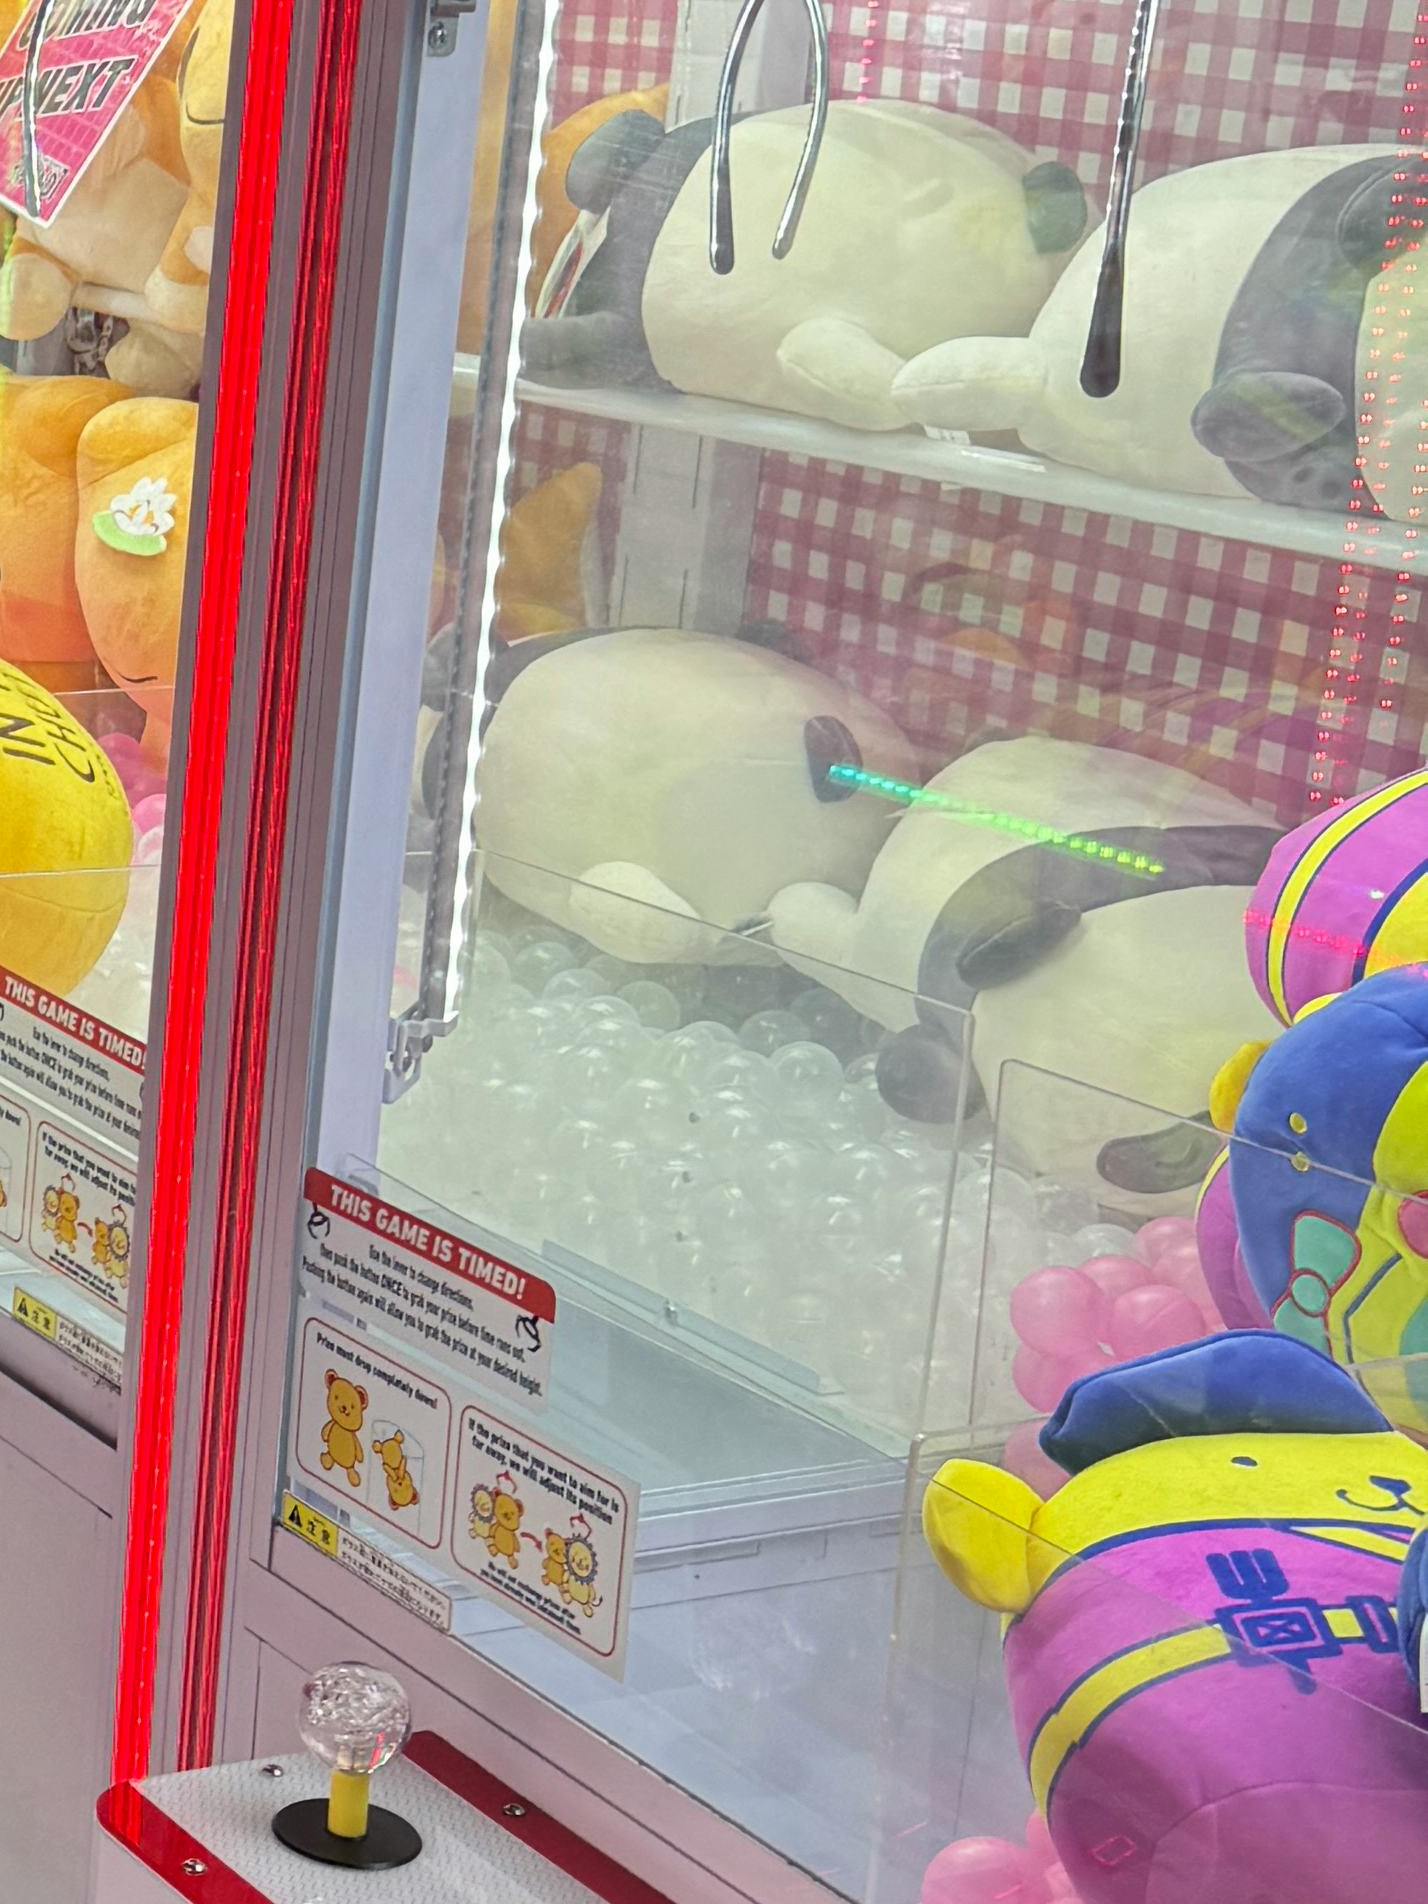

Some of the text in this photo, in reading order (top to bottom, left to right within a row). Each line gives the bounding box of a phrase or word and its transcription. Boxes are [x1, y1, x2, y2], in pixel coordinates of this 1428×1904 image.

[4, 976, 35, 1008] THIS
[38, 996, 76, 1032] GAME
[79, 1017, 94, 1041] IS
[98, 1028, 146, 1069] TIMED!
[331, 1187, 525, 1300] THIS GAME IS TIMED!
